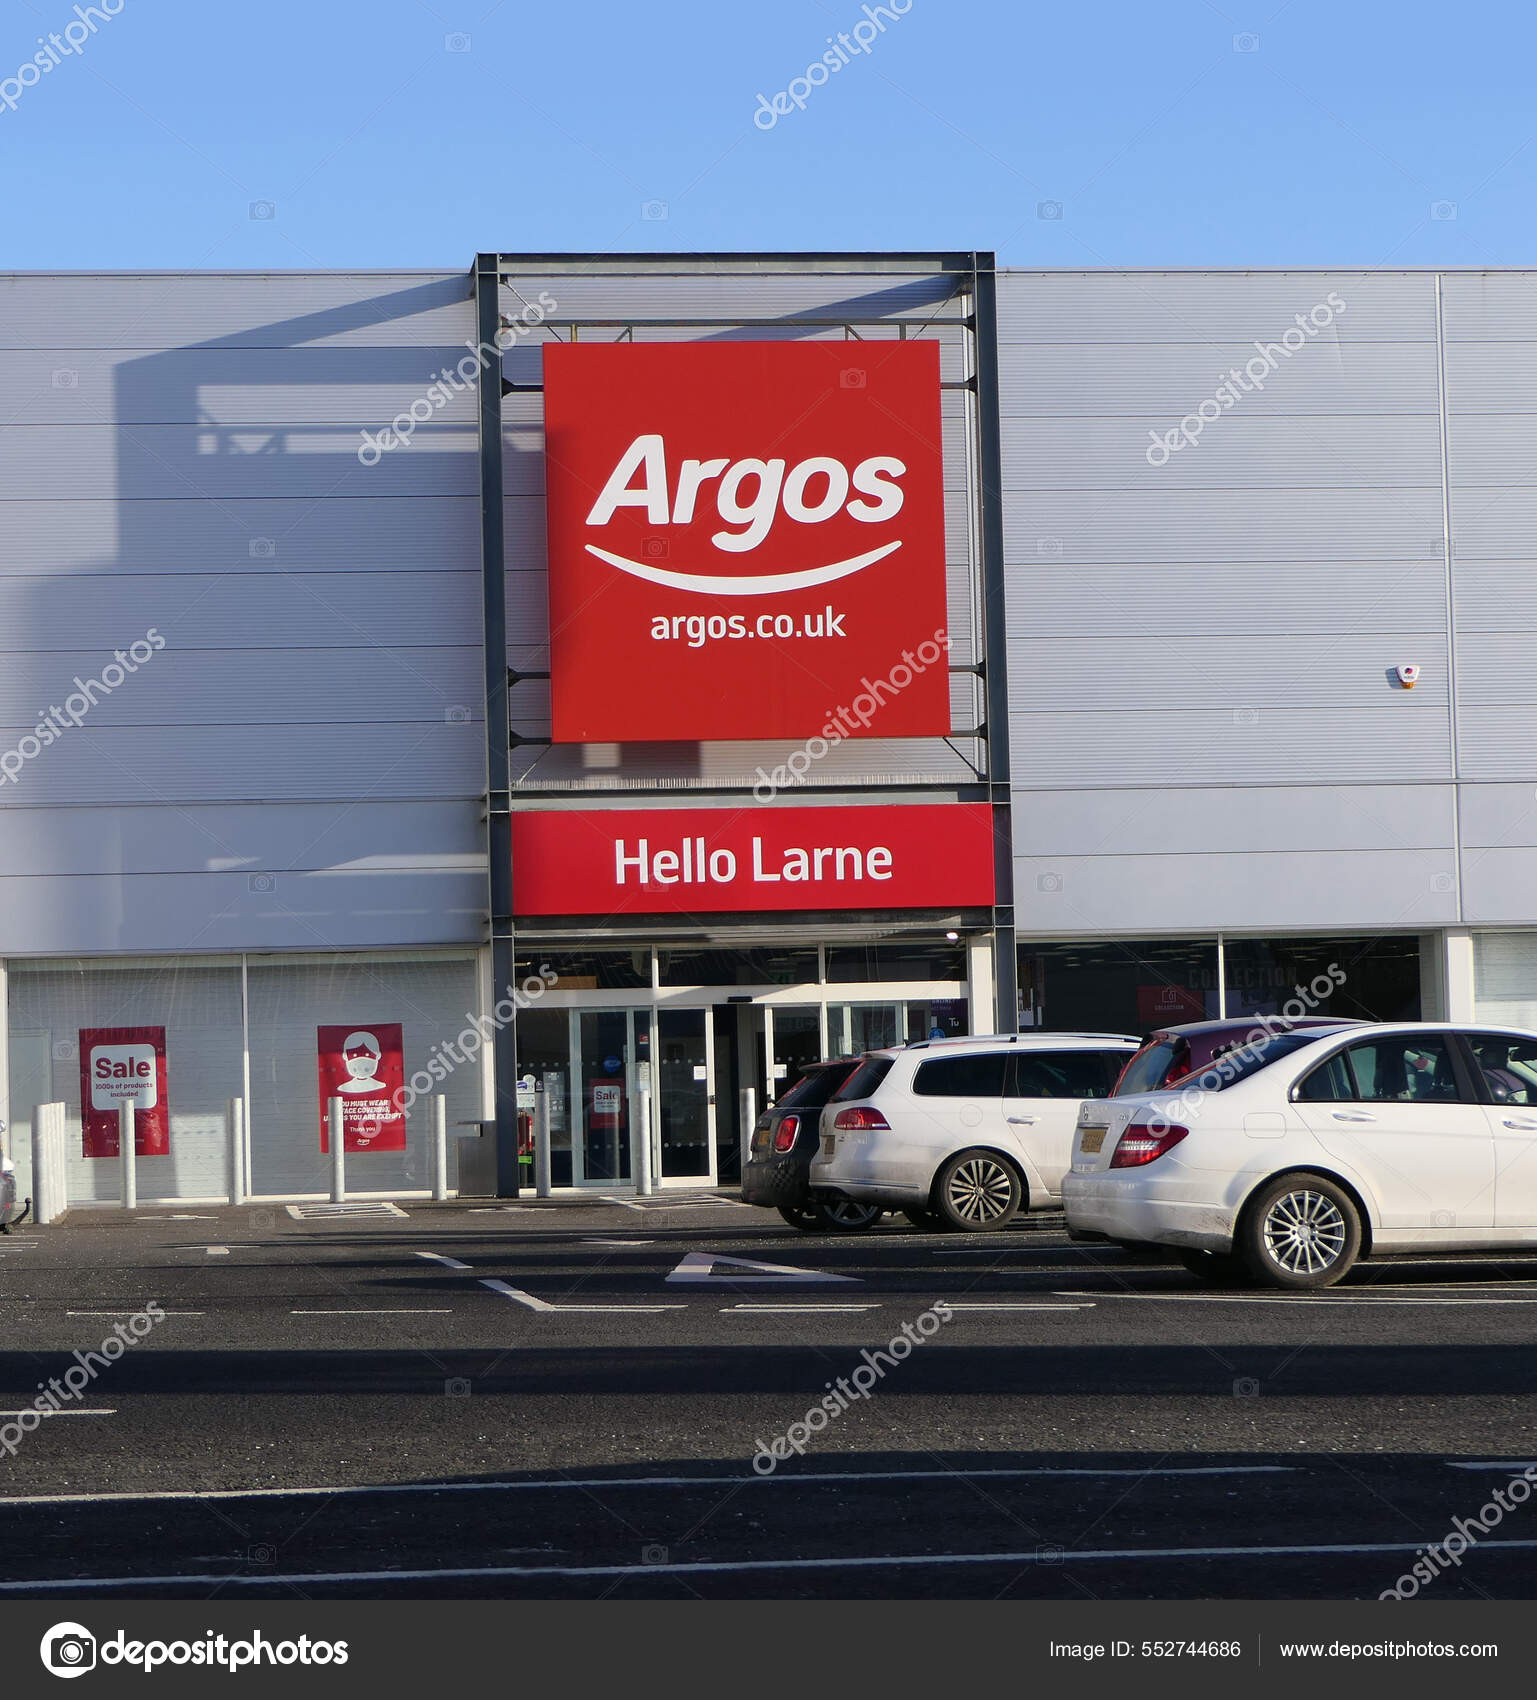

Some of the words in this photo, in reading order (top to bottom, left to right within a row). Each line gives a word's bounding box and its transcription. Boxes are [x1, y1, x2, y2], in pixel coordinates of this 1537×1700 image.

[585, 434, 907, 552] Argos
[650, 606, 847, 648] argos.co.uk
[615, 836, 737, 884] Hello
[752, 836, 893, 882] Larne
[1188, 967, 1297, 989] COLECTION
[95, 1056, 151, 1079] Sale
[124, 1081, 153, 1091] products
[368, 1099, 389, 1107] WEAR
[365, 1126, 376, 1134] you
